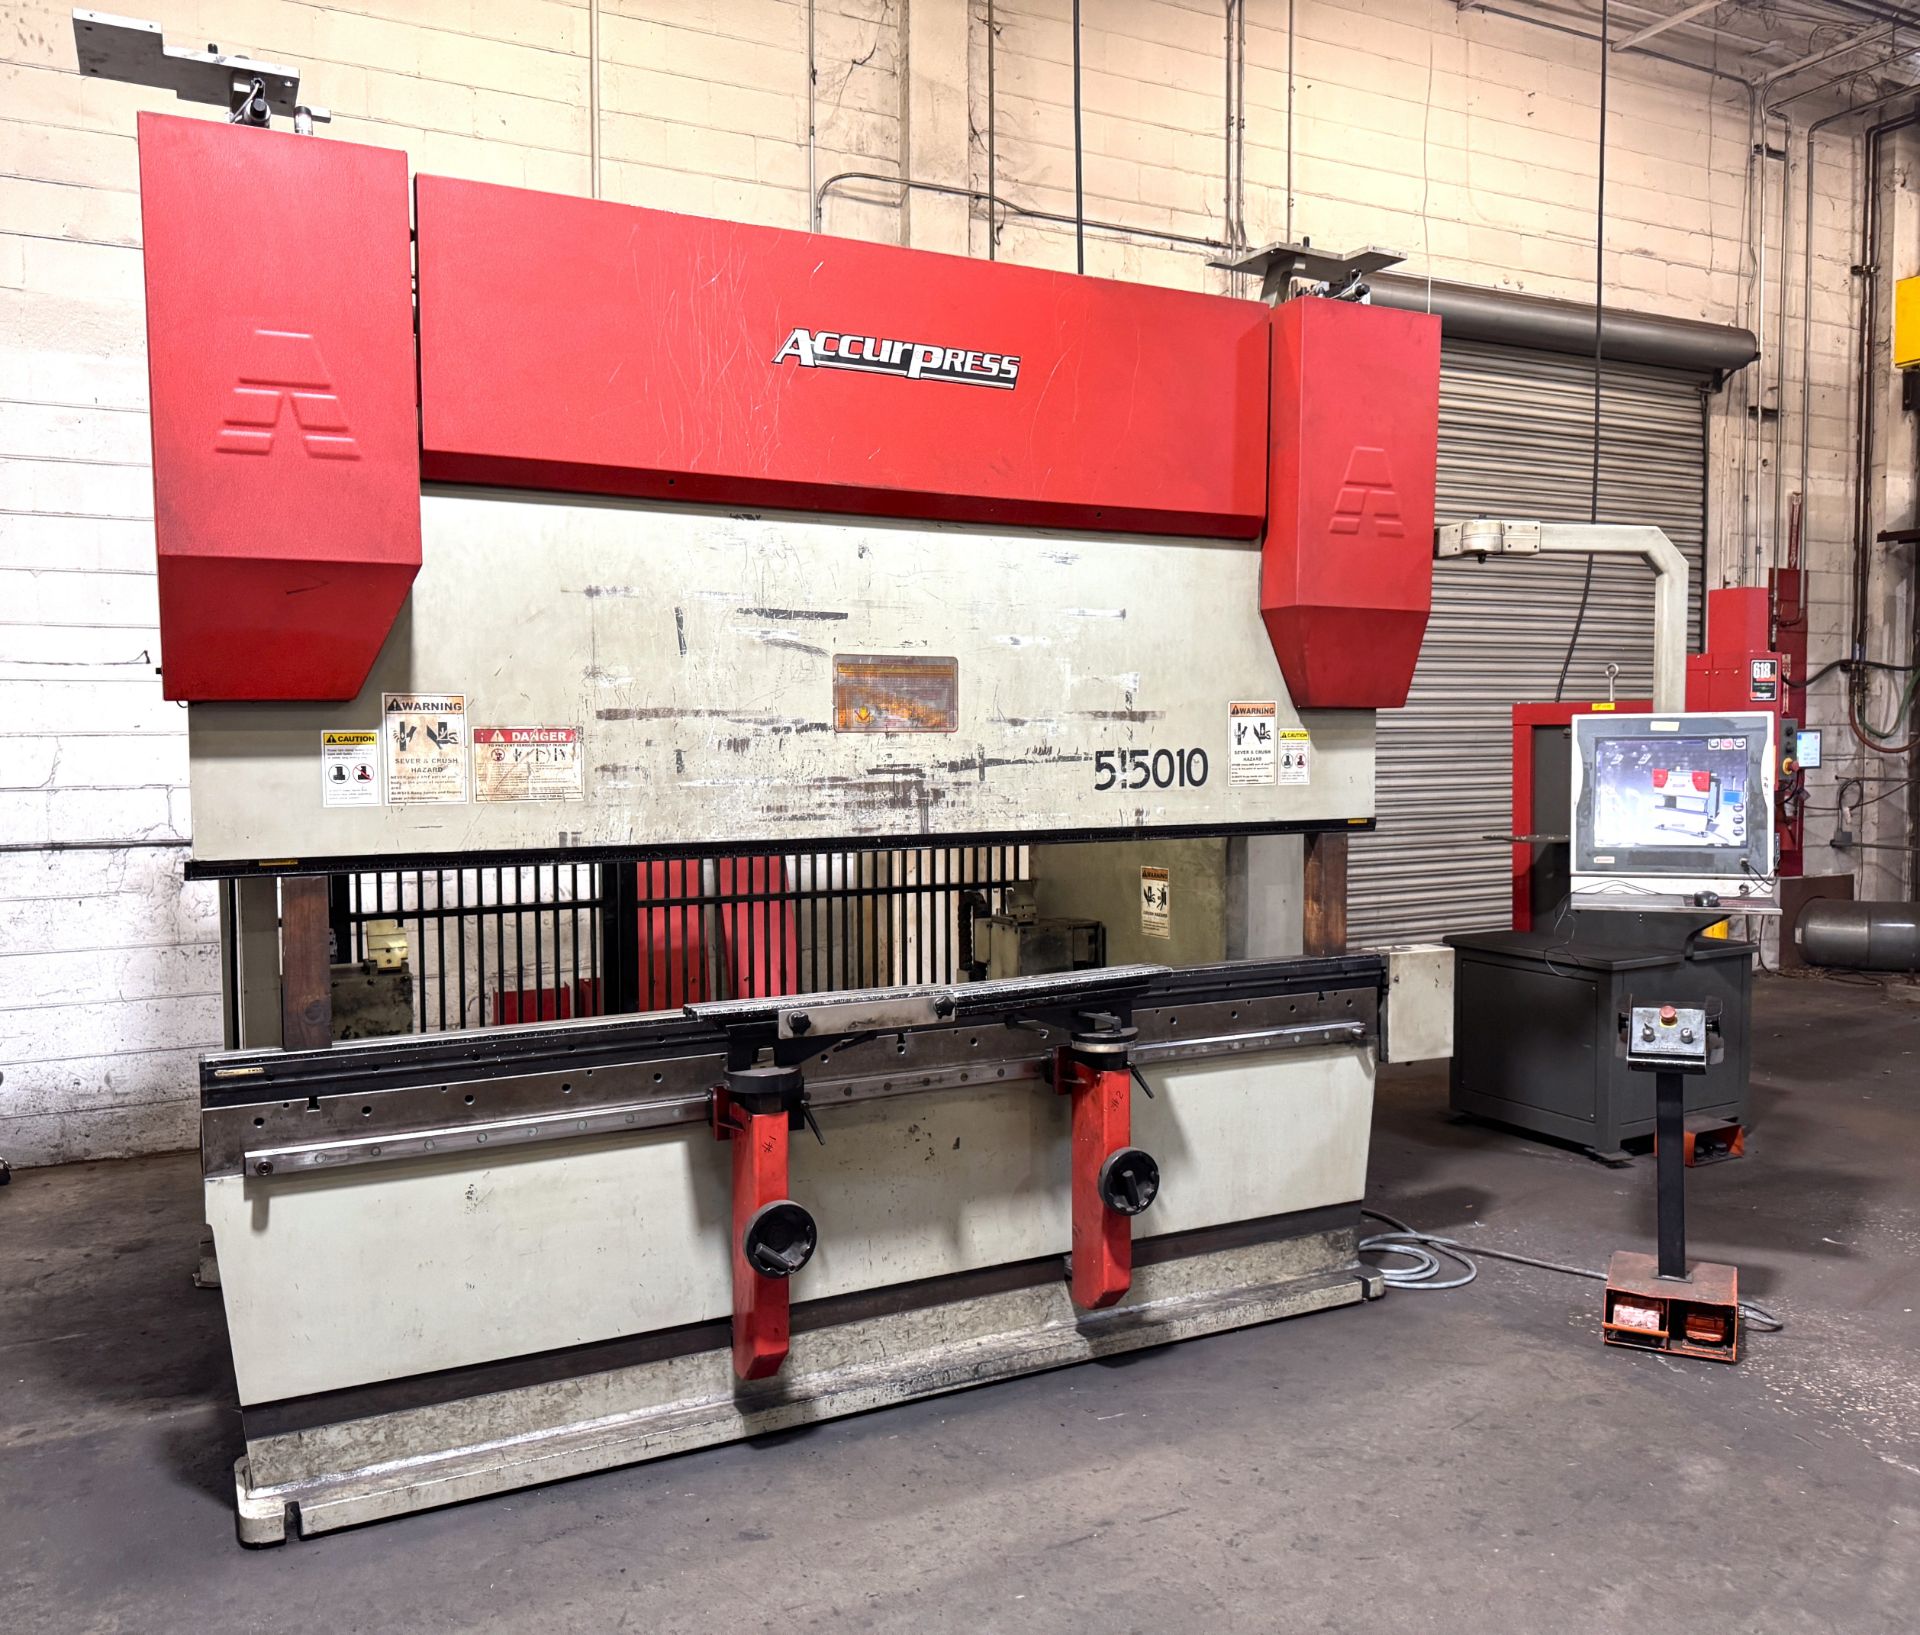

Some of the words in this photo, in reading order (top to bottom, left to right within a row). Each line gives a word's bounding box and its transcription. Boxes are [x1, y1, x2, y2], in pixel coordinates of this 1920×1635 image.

[401, 702, 462, 711] WARNING
[1240, 707, 1275, 715] WARNING
[337, 735, 375, 743] CAUTION
[511, 731, 567, 742] DANGER
